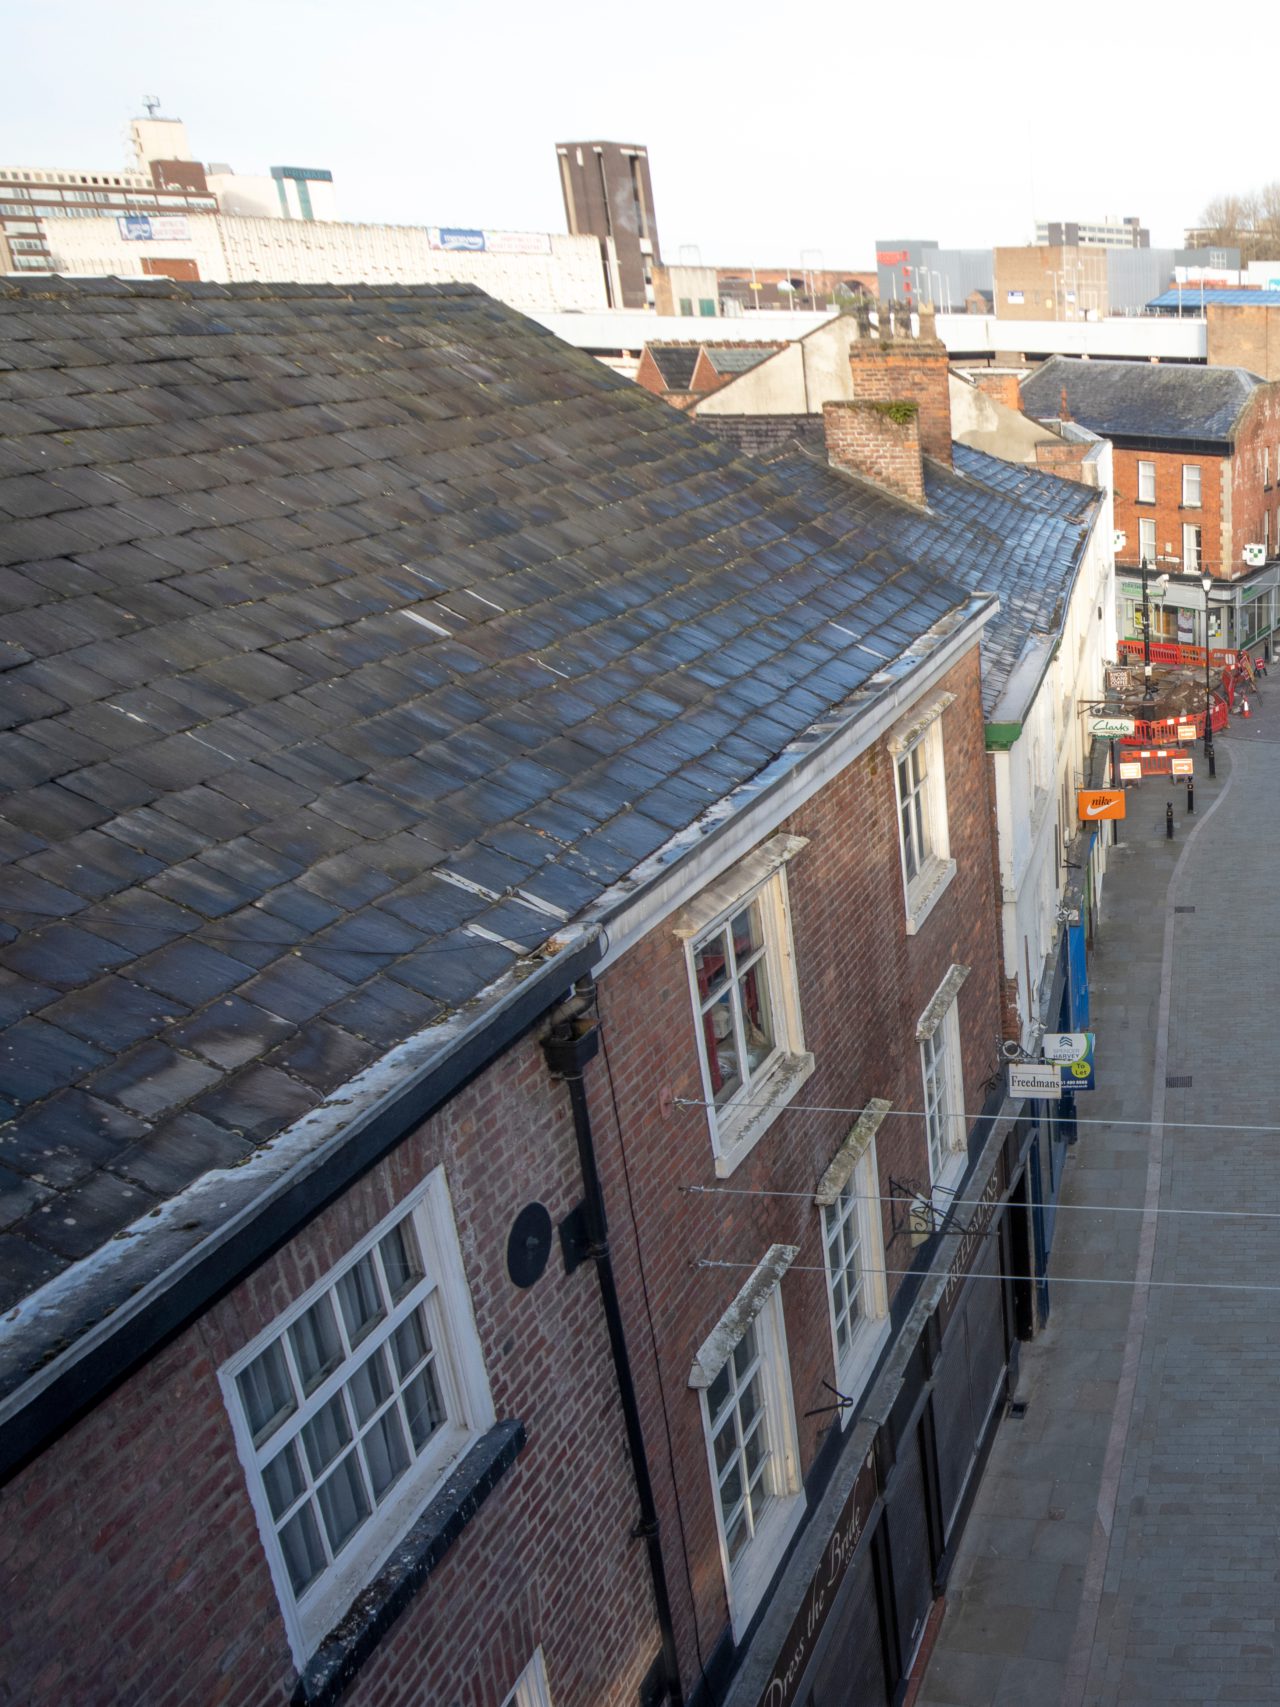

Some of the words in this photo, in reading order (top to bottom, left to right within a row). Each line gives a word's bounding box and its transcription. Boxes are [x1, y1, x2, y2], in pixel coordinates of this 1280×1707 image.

[1092, 719, 1130, 732] Clarks
[1092, 796, 1112, 806] nike
[1011, 1075, 1060, 1089] Freedmans
[764, 1638, 805, 1707] Dress
[807, 1563, 826, 1638] the
[827, 1478, 861, 1586] Bride
